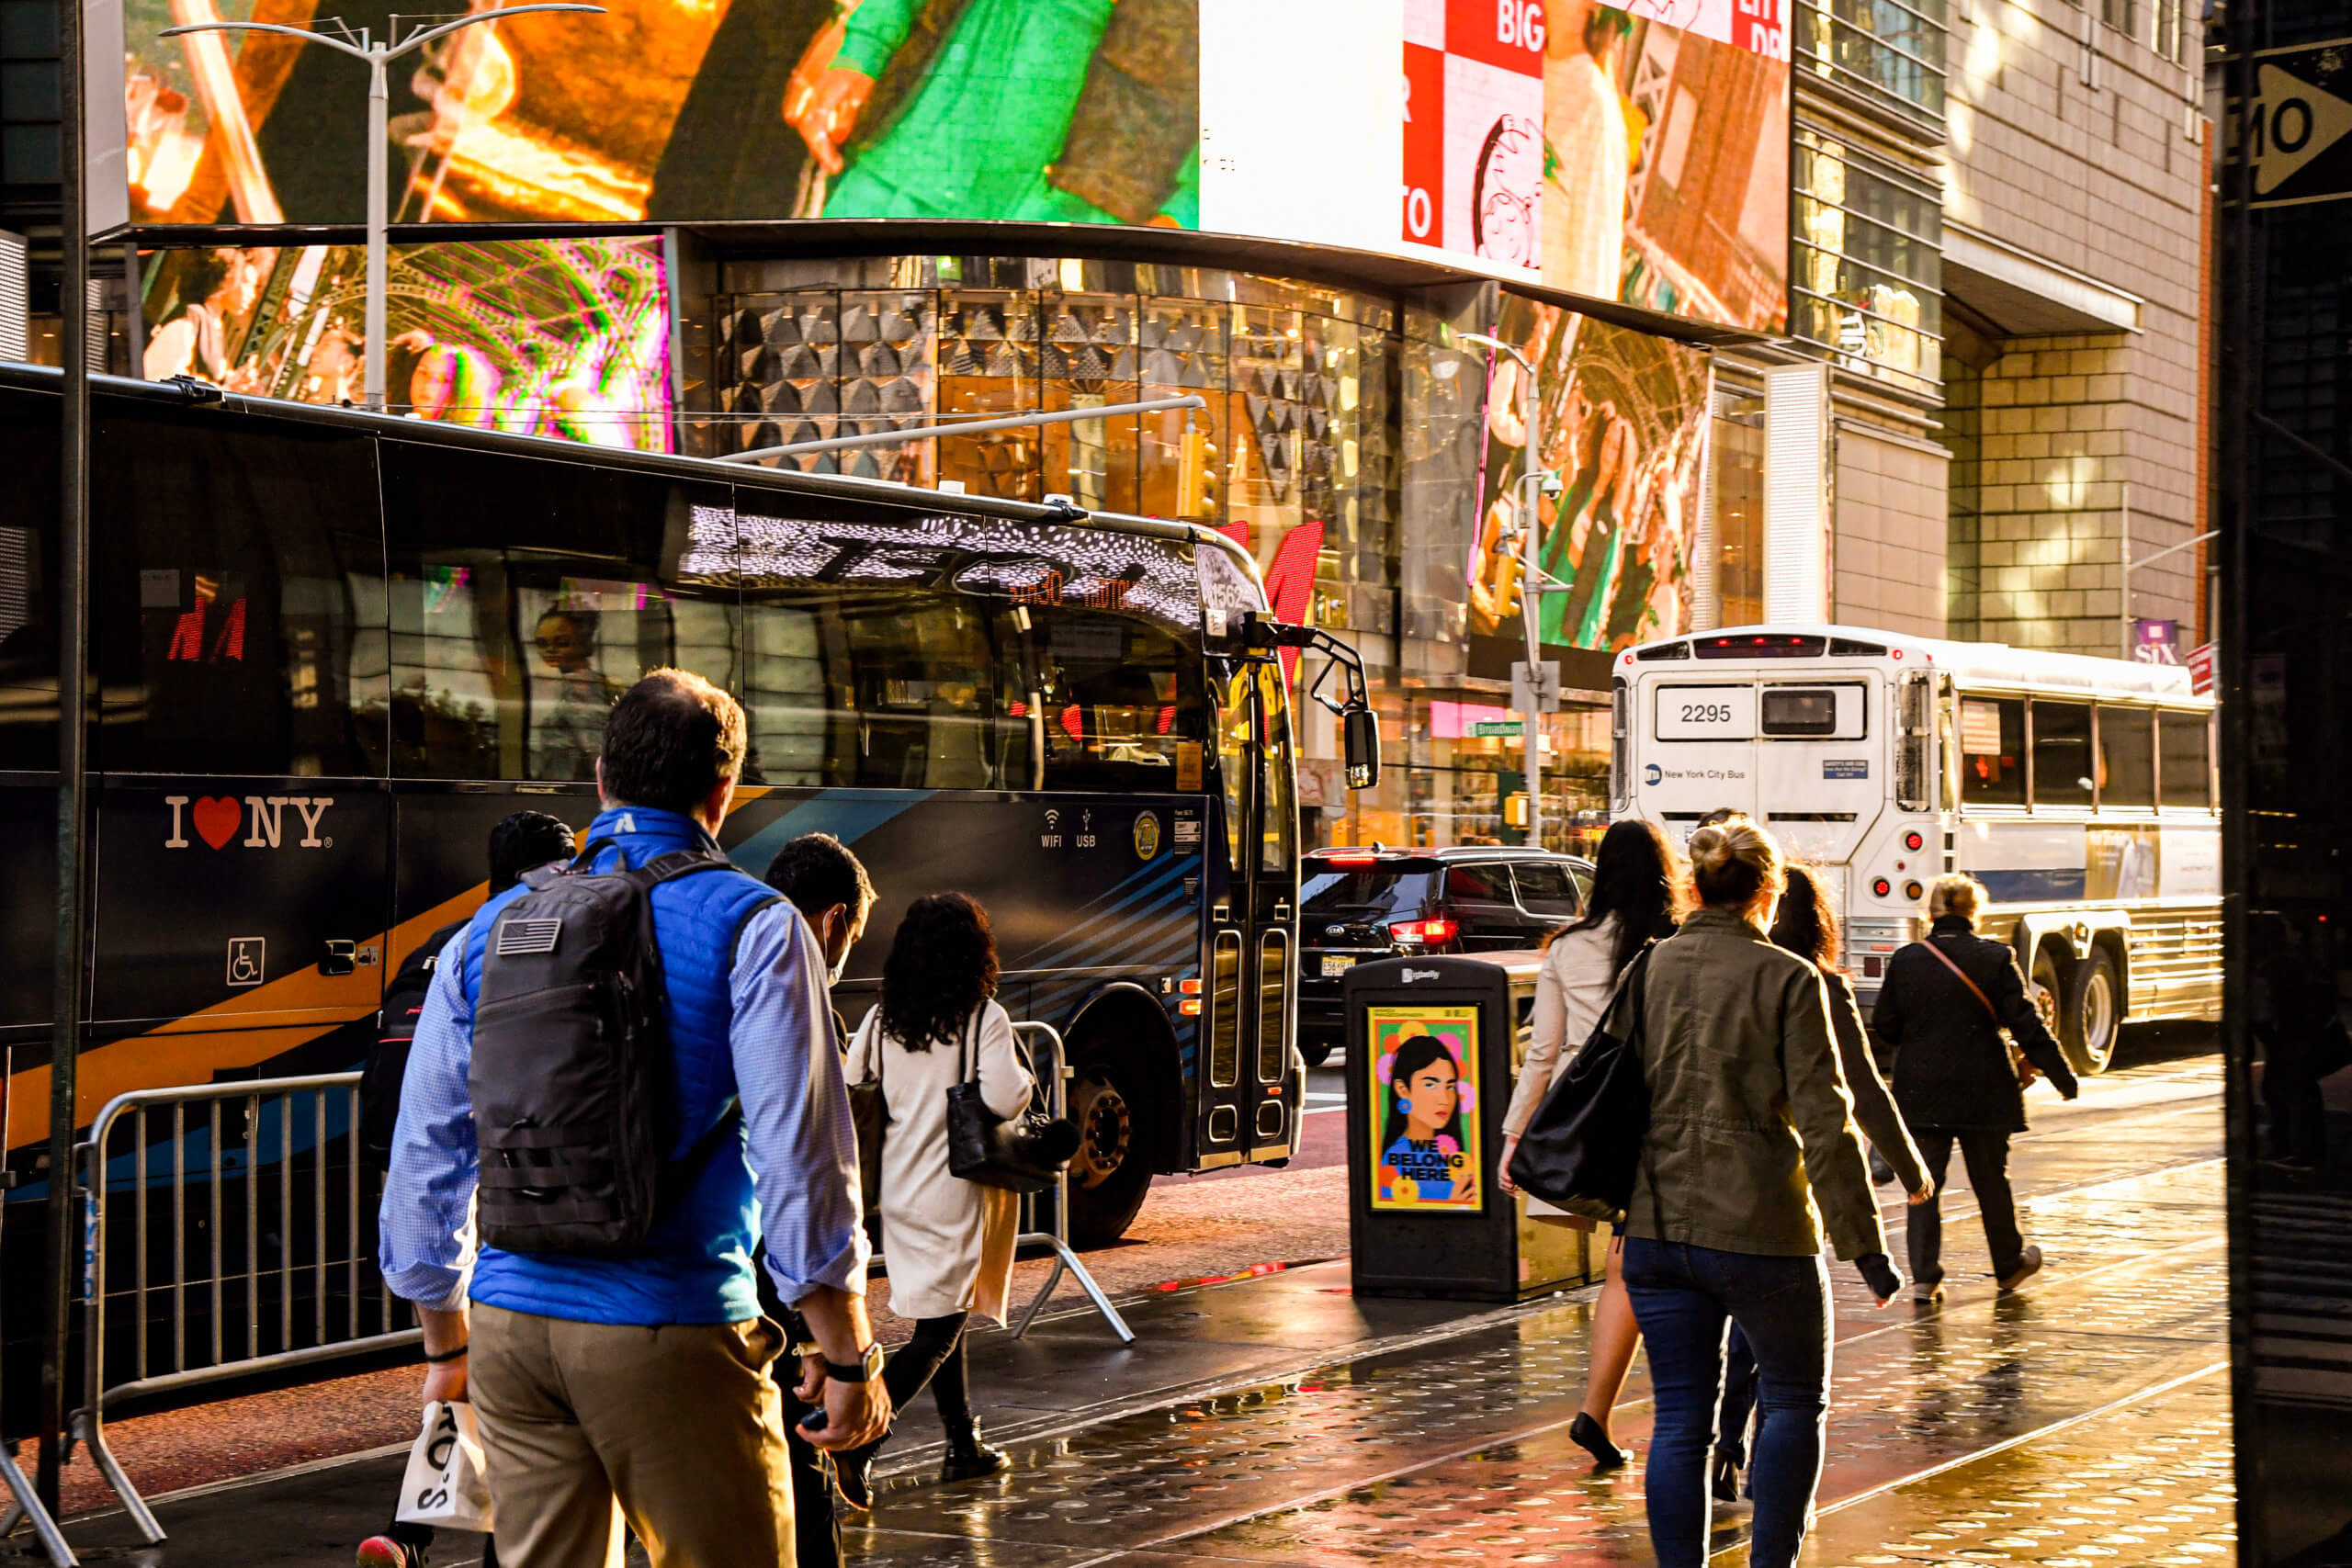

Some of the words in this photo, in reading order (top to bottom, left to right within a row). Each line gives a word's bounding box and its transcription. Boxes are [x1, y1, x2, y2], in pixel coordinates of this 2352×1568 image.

[1498, 0, 1544, 51] BIG
[1402, 186, 1431, 237] O
[1680, 705, 1731, 722] 2295
[1665, 770, 1683, 779] New
[1686, 770, 1704, 779] York
[1707, 770, 1725, 780] City
[1727, 770, 1746, 779] Bus
[164, 795, 189, 849] I
[1041, 834, 1063, 848] WIFI
[1076, 834, 1096, 848] USB
[1408, 1139, 1439, 1153] WE
[1388, 1153, 1464, 1168] BELONG
[1402, 1168, 1451, 1181] HERE
